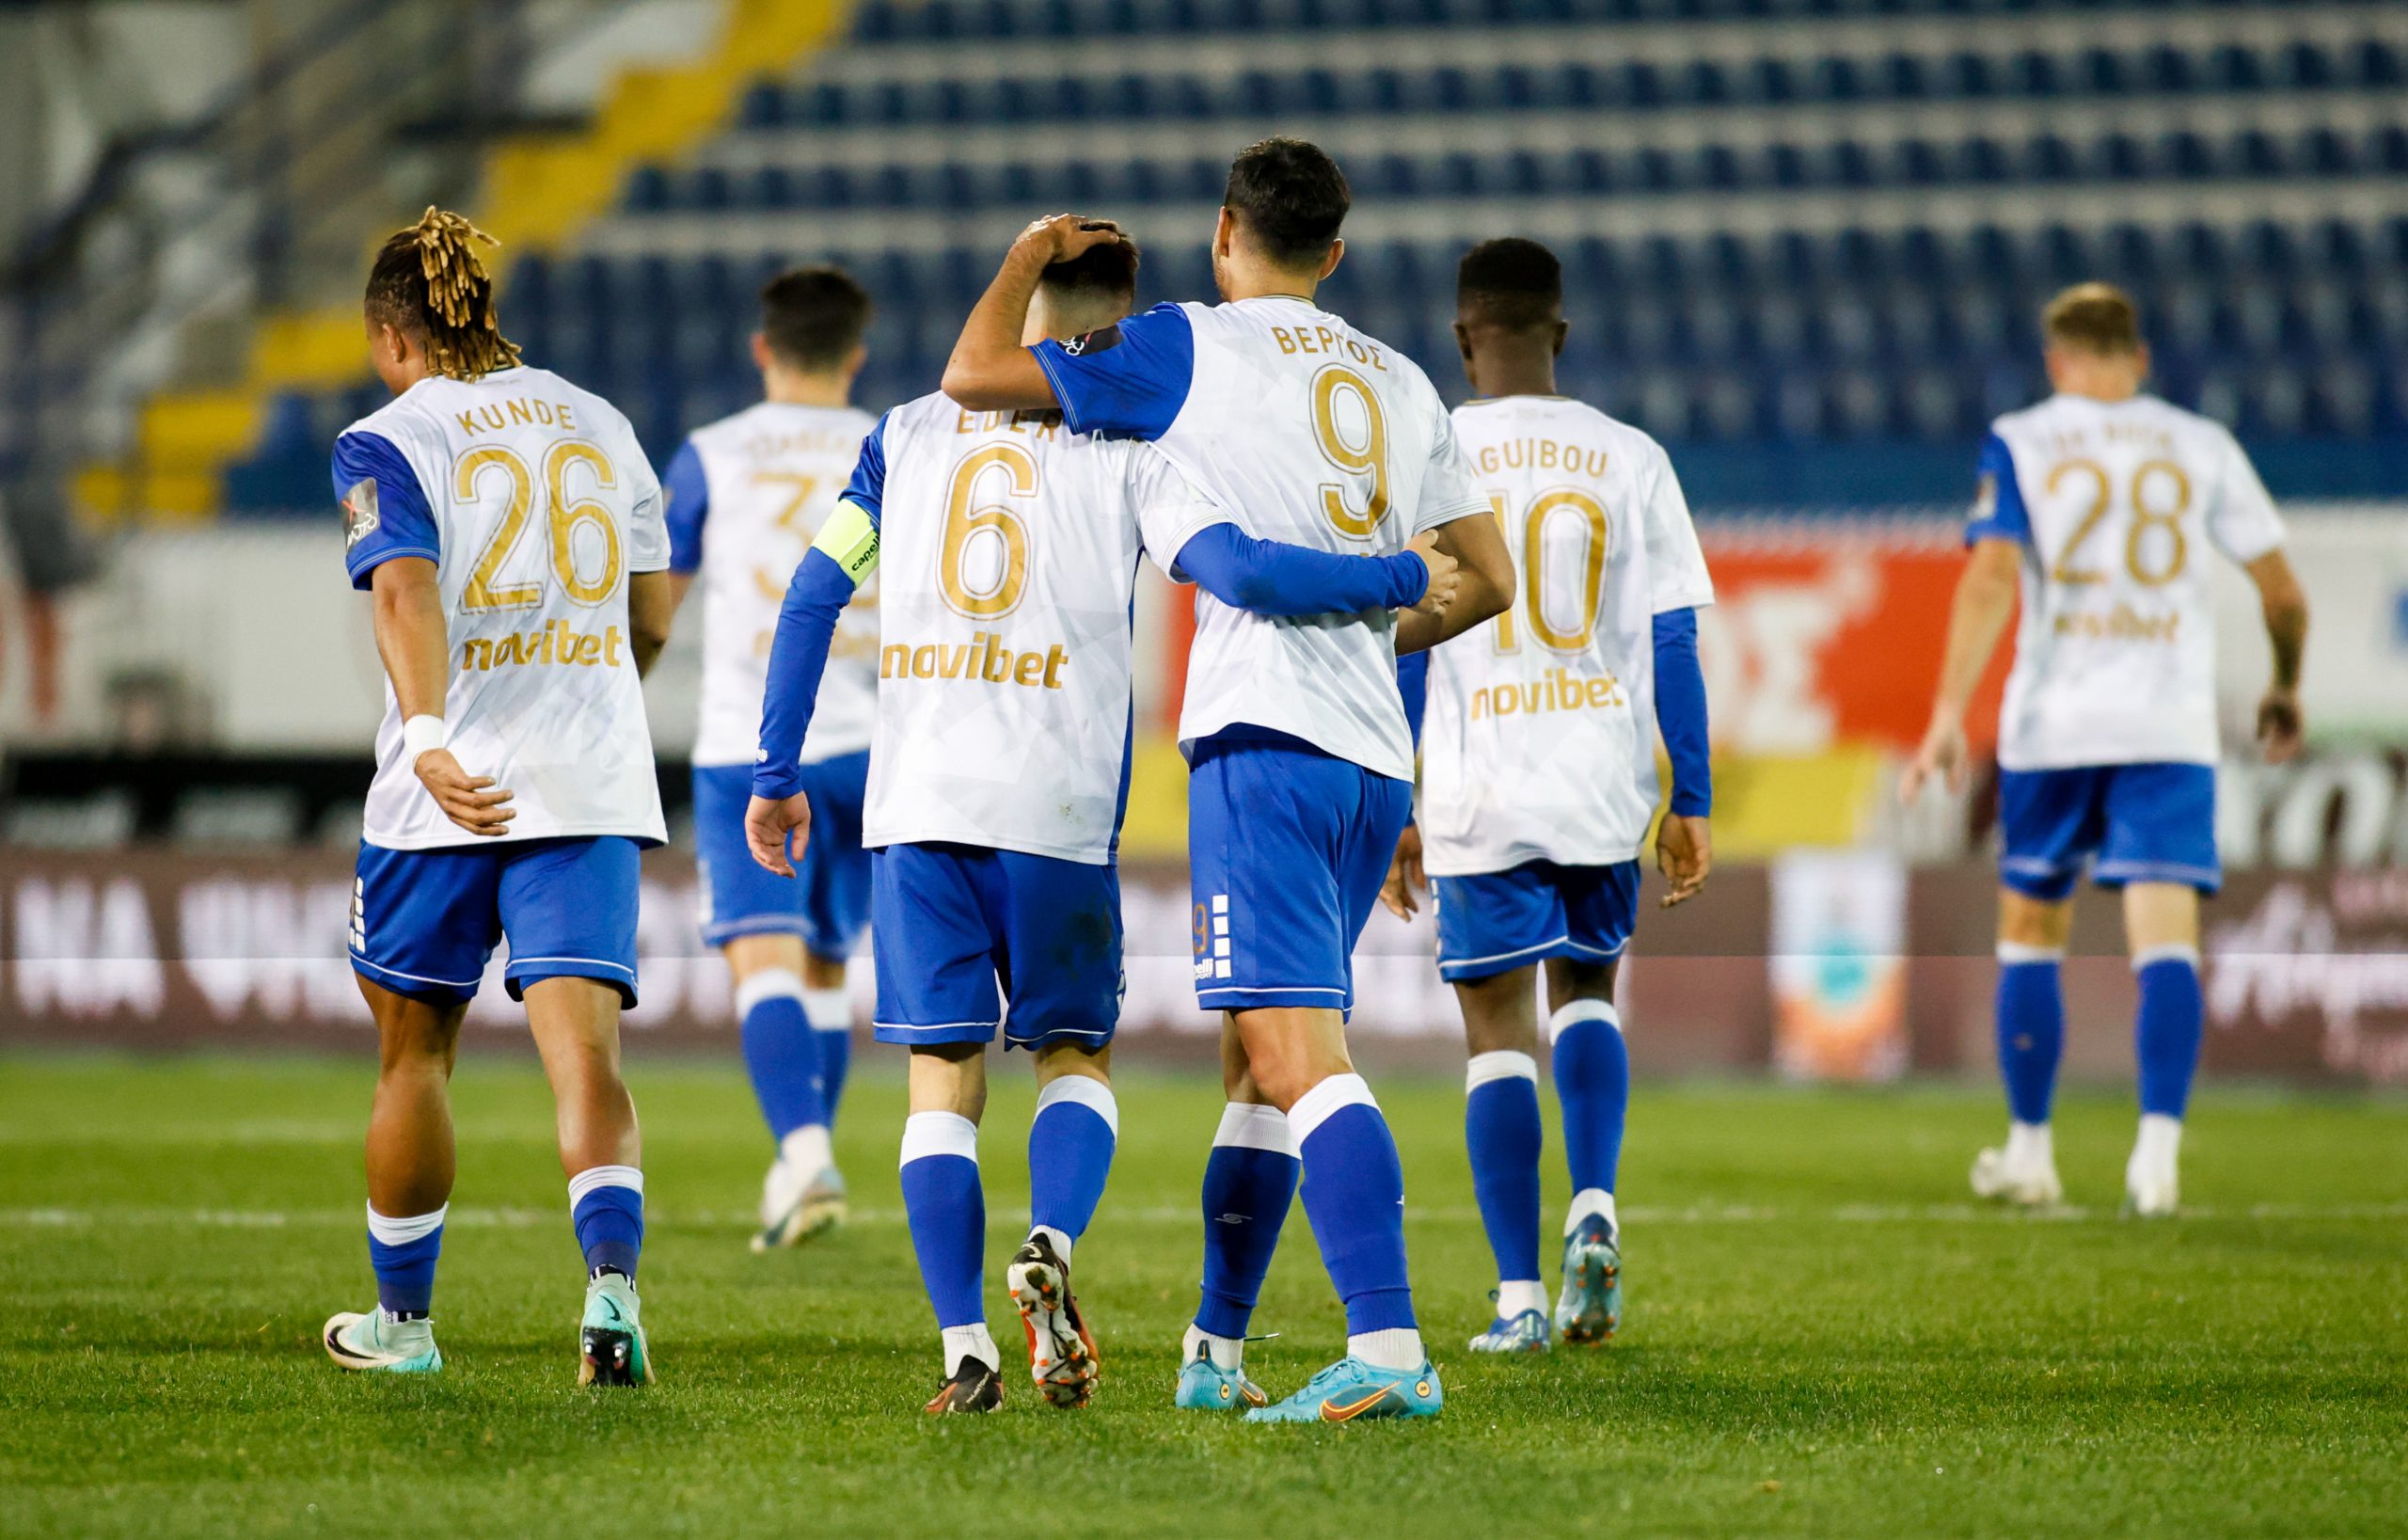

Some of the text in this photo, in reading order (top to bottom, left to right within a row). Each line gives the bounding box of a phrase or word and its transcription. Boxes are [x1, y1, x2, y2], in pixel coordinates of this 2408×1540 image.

[455, 396, 576, 437] KUNDE
[1308, 362, 1393, 542] 9
[1465, 437, 1608, 478] GUIBOU
[451, 437, 626, 617] 26
[935, 440, 1040, 621] 6
[2045, 458, 2192, 587] 28
[1484, 484, 1613, 657] 10
[462, 618, 624, 671] novibet
[880, 632, 1069, 689] novibet
[1193, 903, 1209, 954] 9
